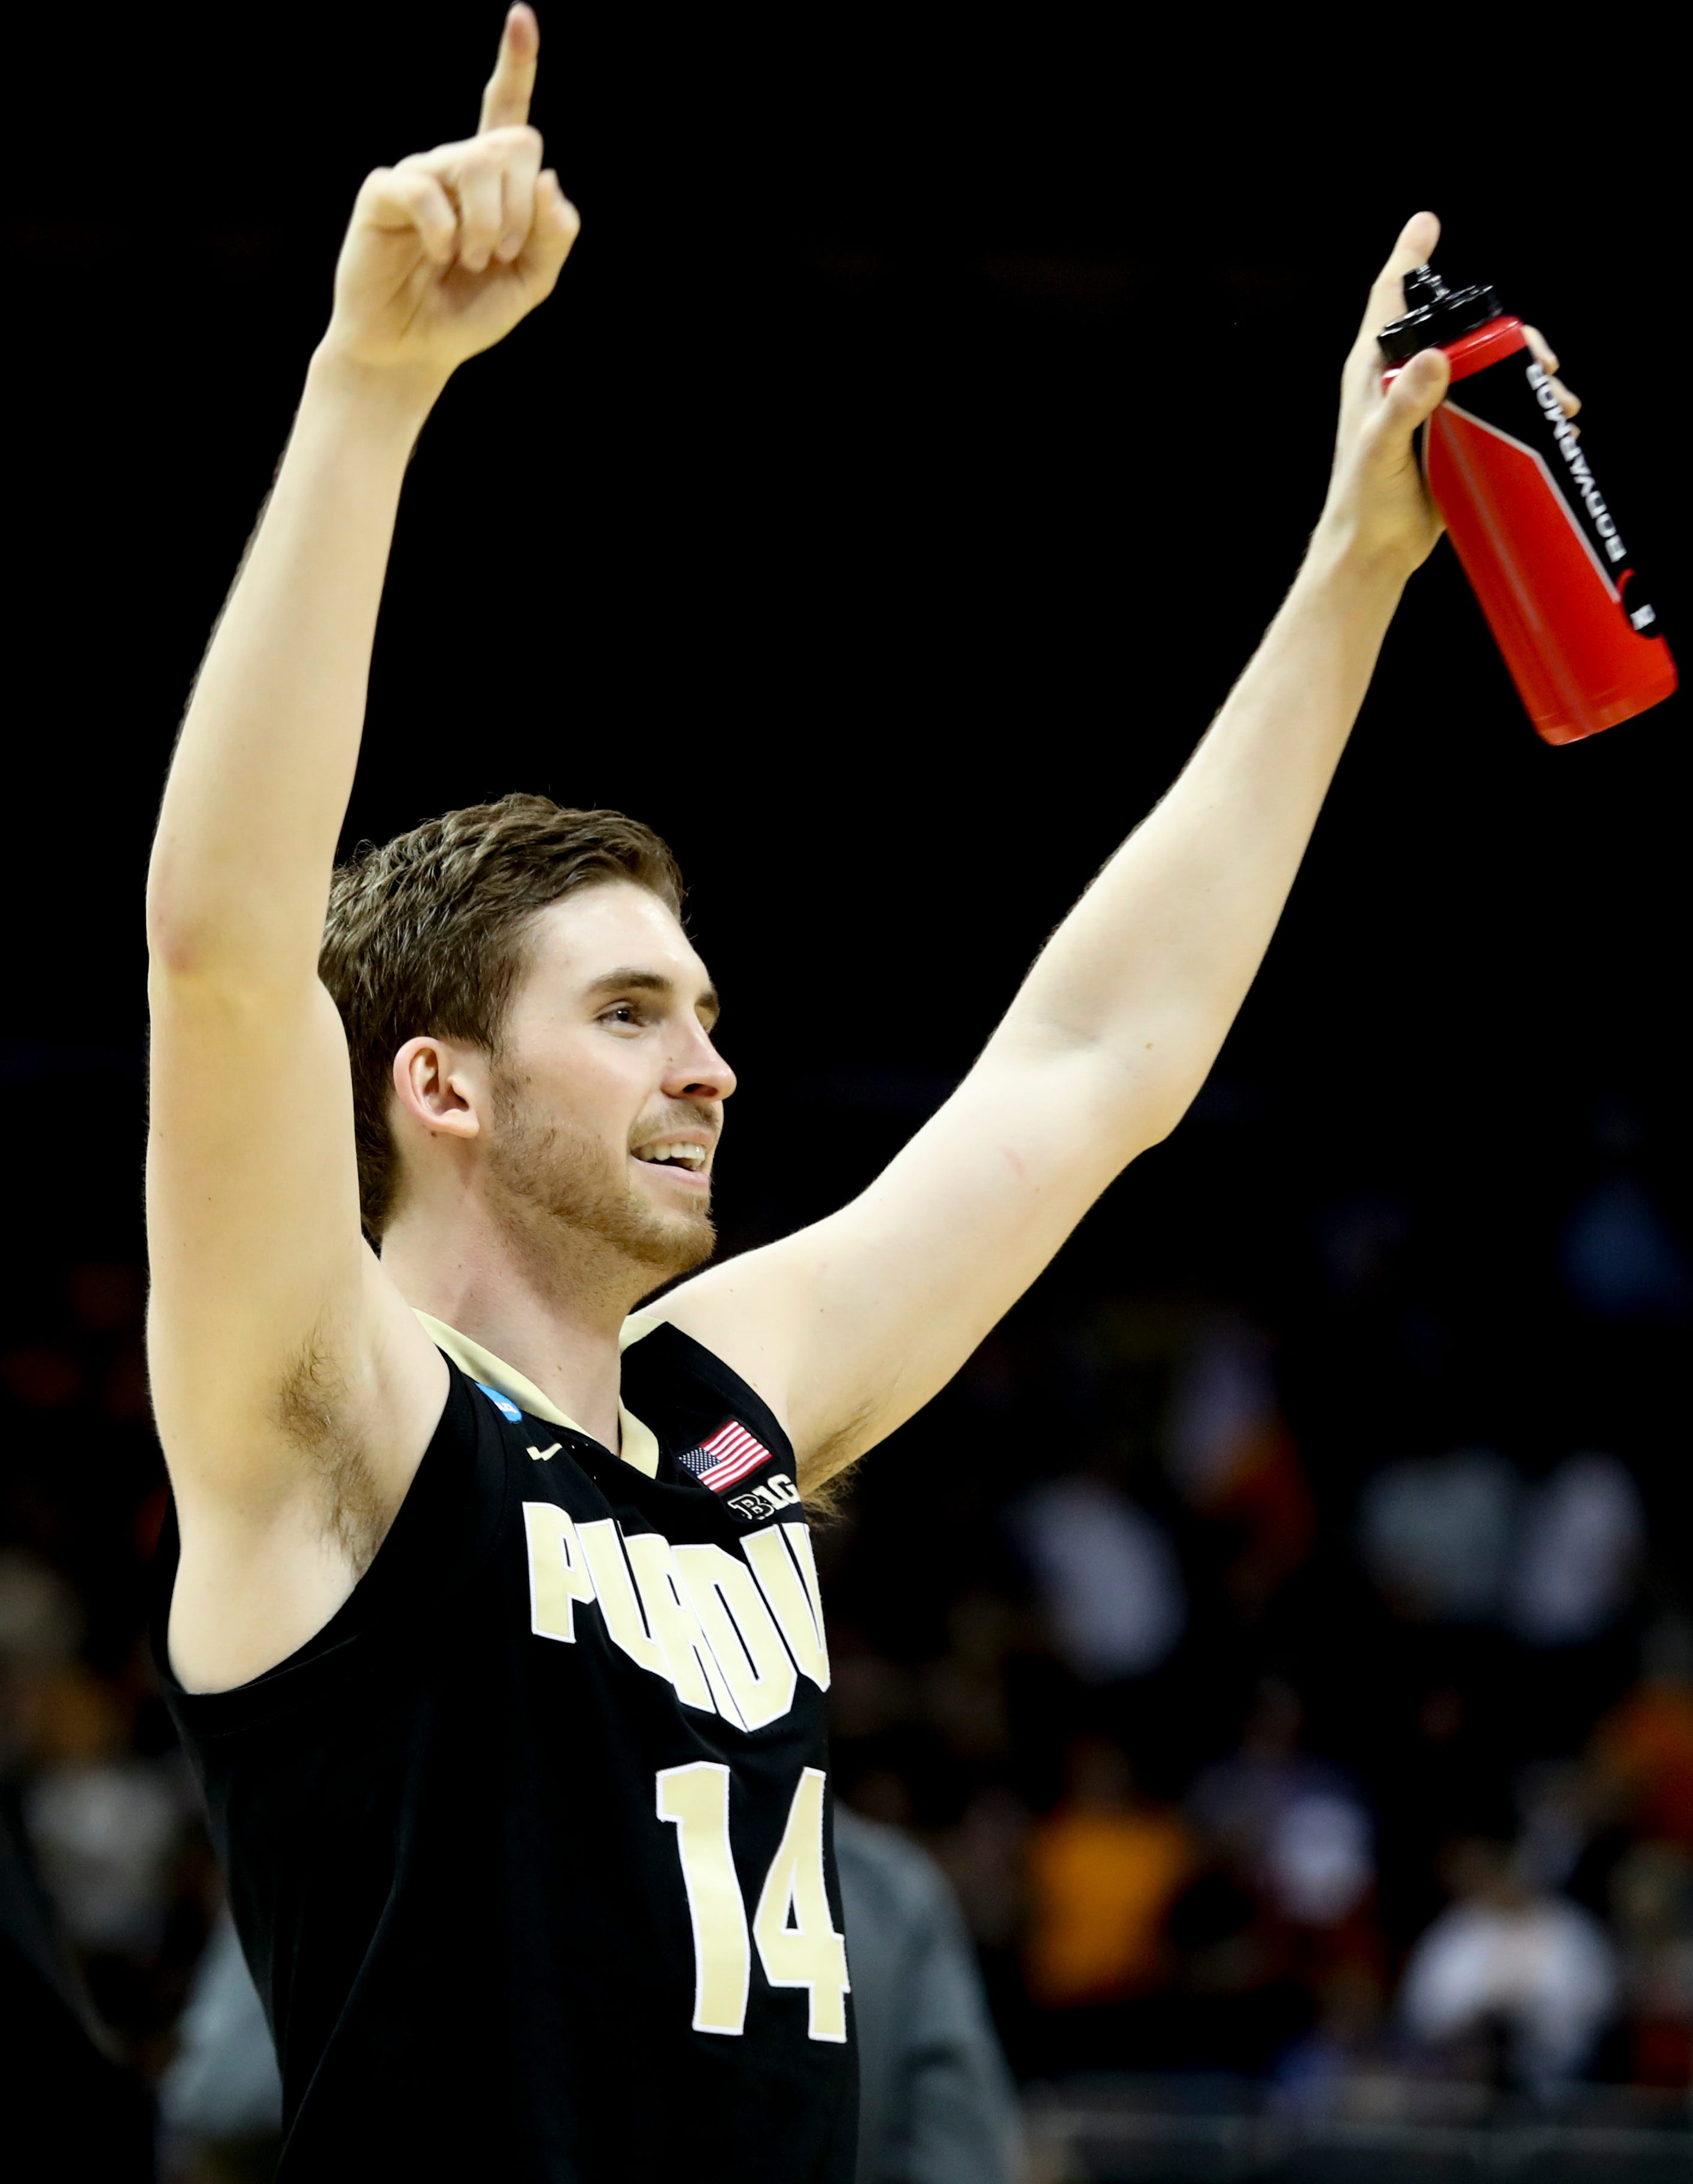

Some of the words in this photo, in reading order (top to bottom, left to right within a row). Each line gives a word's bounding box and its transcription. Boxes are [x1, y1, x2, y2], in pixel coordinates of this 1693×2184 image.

[1526, 363, 1627, 563] BODYARMOR
[522, 1501, 831, 1733] PURDU
[656, 1760, 851, 2044] 14
